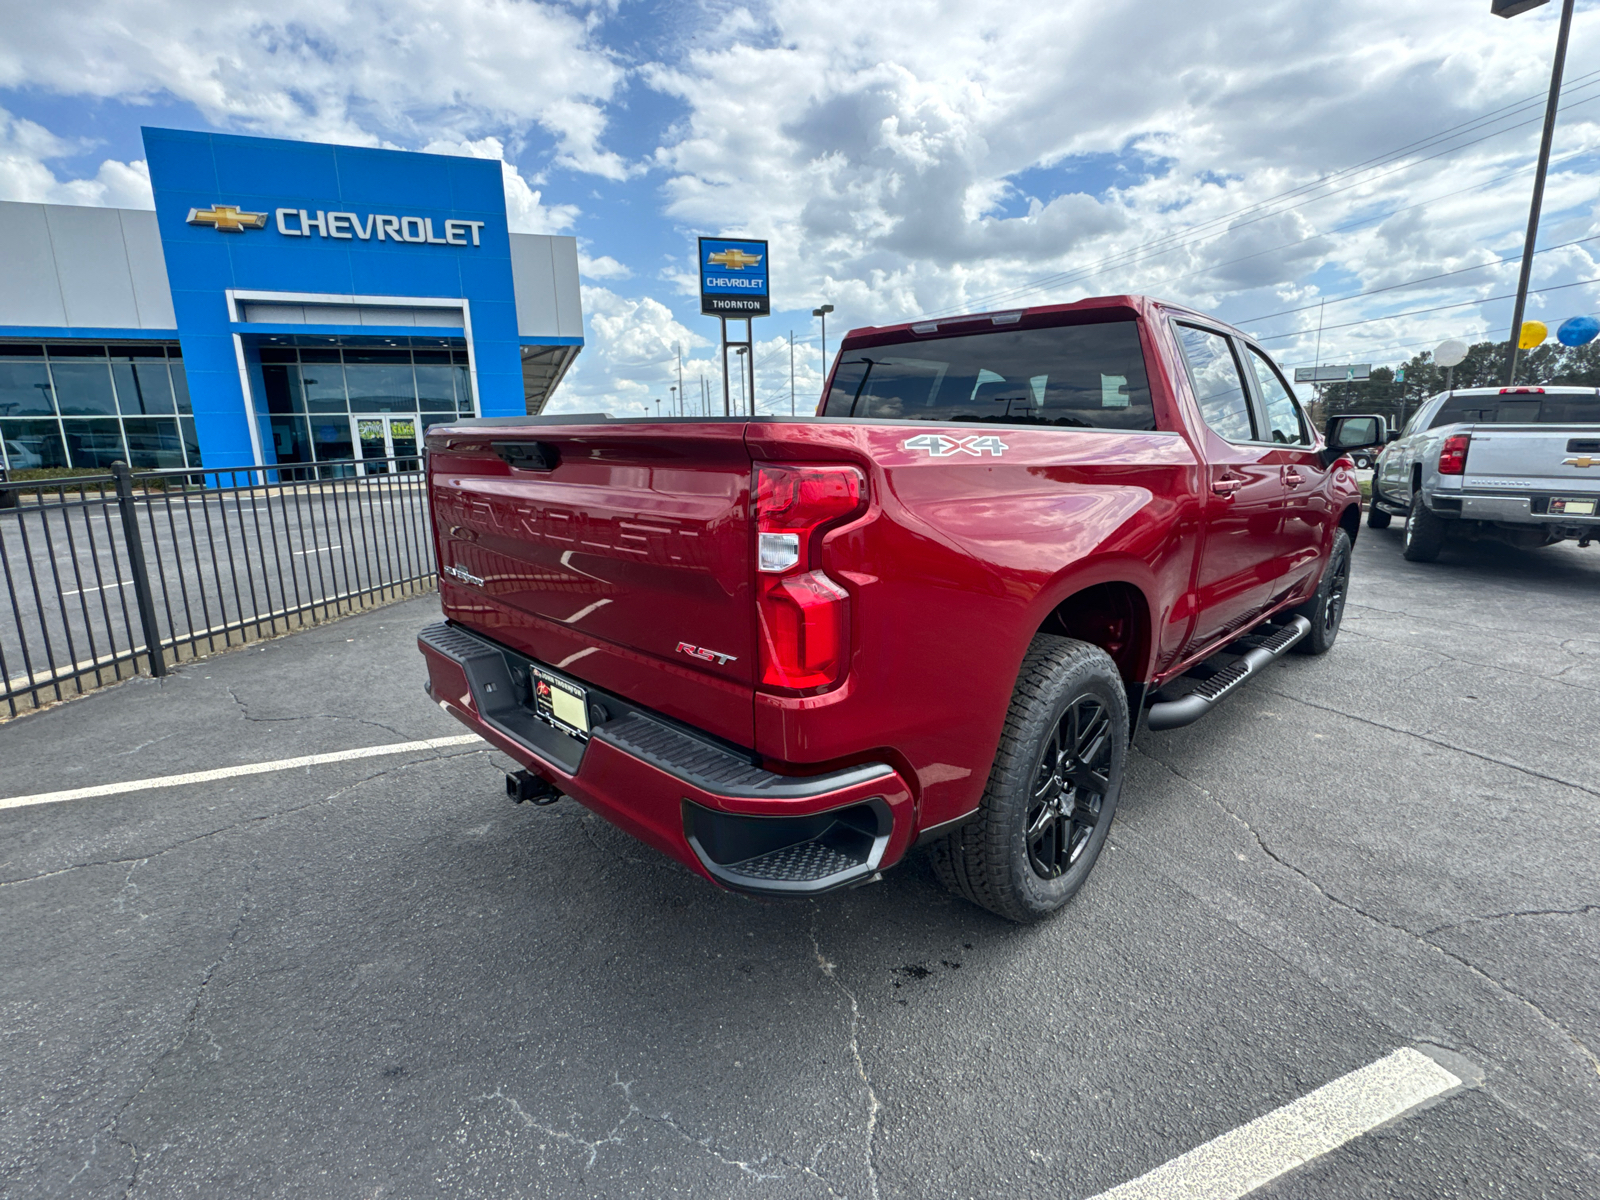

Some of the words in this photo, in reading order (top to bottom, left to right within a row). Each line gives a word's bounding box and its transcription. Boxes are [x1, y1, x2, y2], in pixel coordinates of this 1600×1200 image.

[275, 207, 485, 247] CHEVROLET
[706, 277, 764, 288] CHEVROLET
[712, 300, 761, 309] THORNTON
[904, 434, 1009, 457] 4X4
[675, 641, 739, 665] RST
